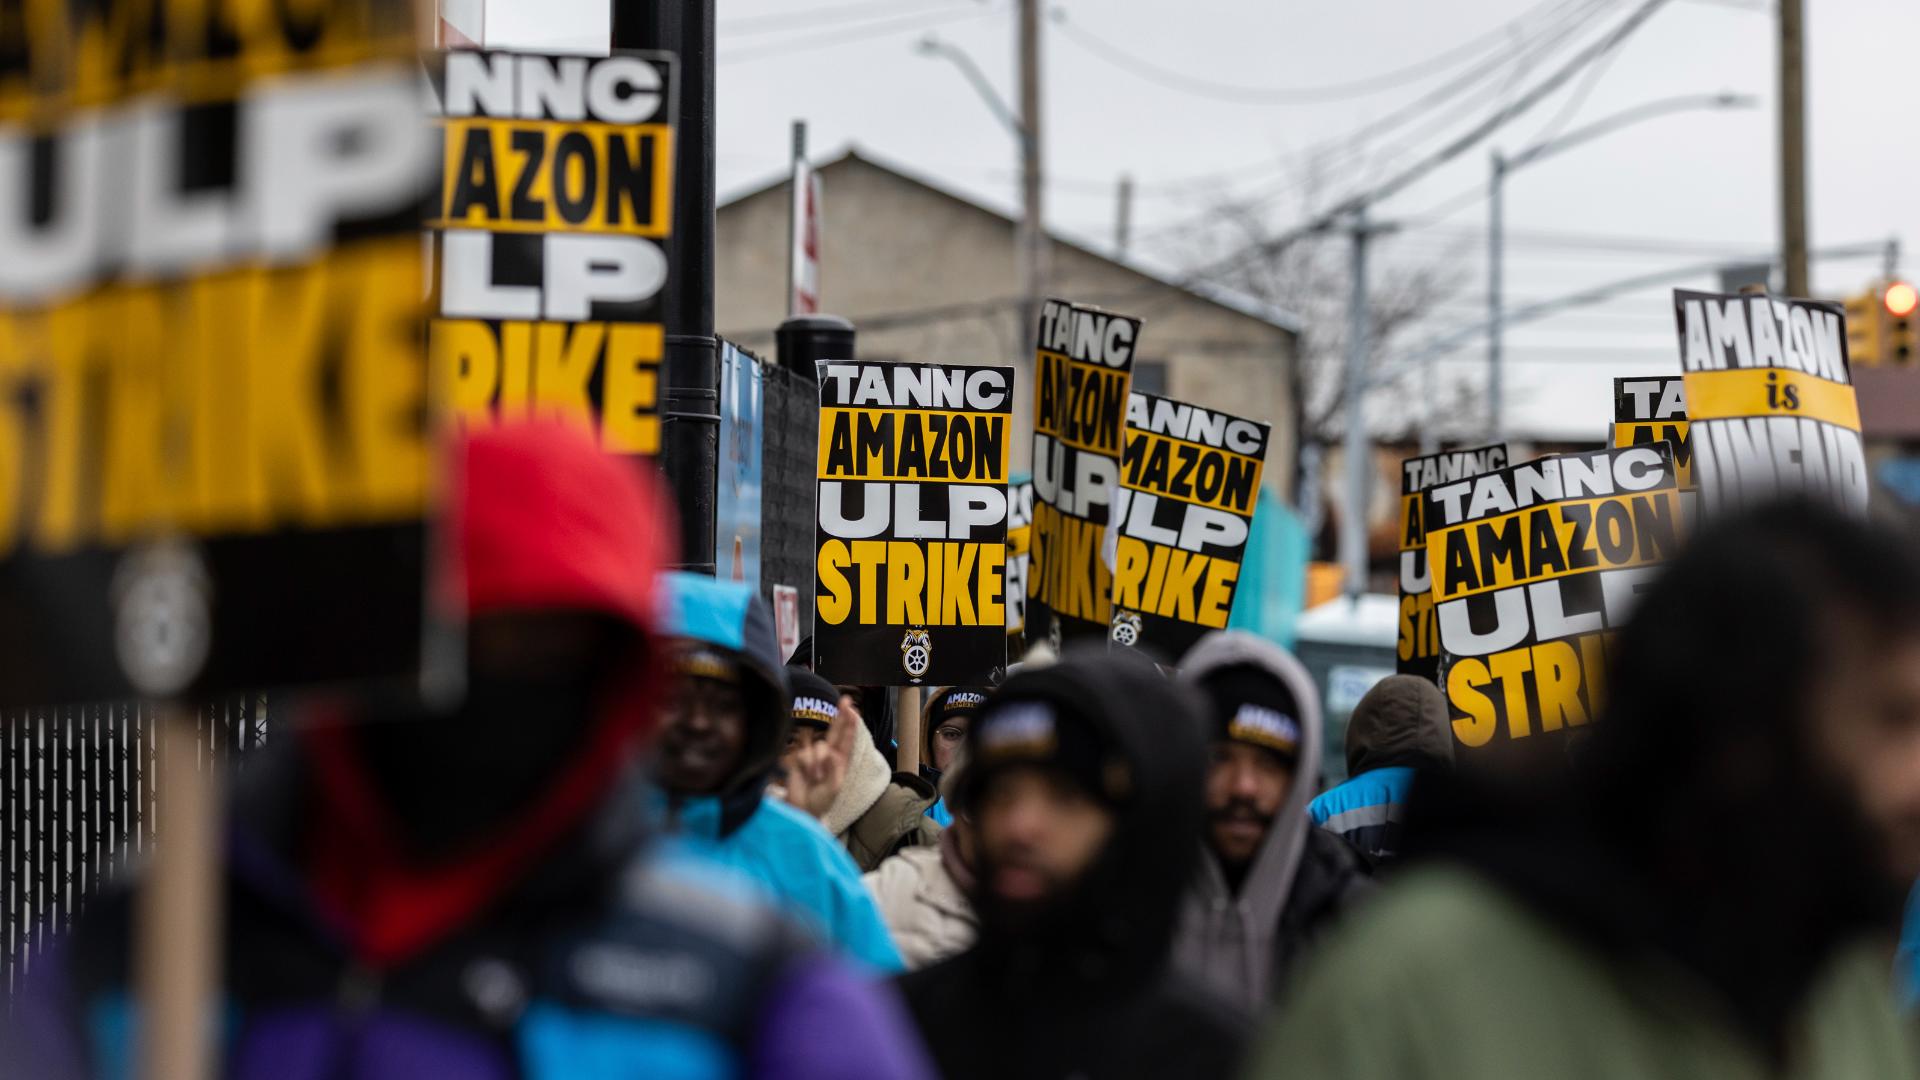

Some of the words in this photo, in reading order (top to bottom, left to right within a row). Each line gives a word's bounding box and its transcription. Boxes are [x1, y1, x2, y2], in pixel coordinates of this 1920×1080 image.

[438, 127, 655, 225] AZON
[424, 230, 667, 320] LP
[1684, 298, 1850, 386] AMAZON
[828, 363, 1006, 410] TANNC
[1765, 371, 1800, 410] is
[826, 411, 1004, 480] AMAZON
[1431, 448, 1665, 525] TANNC
[819, 481, 1007, 539] ULP
[1444, 493, 1680, 597] AMAZON
[817, 538, 1006, 626] STRIKE
